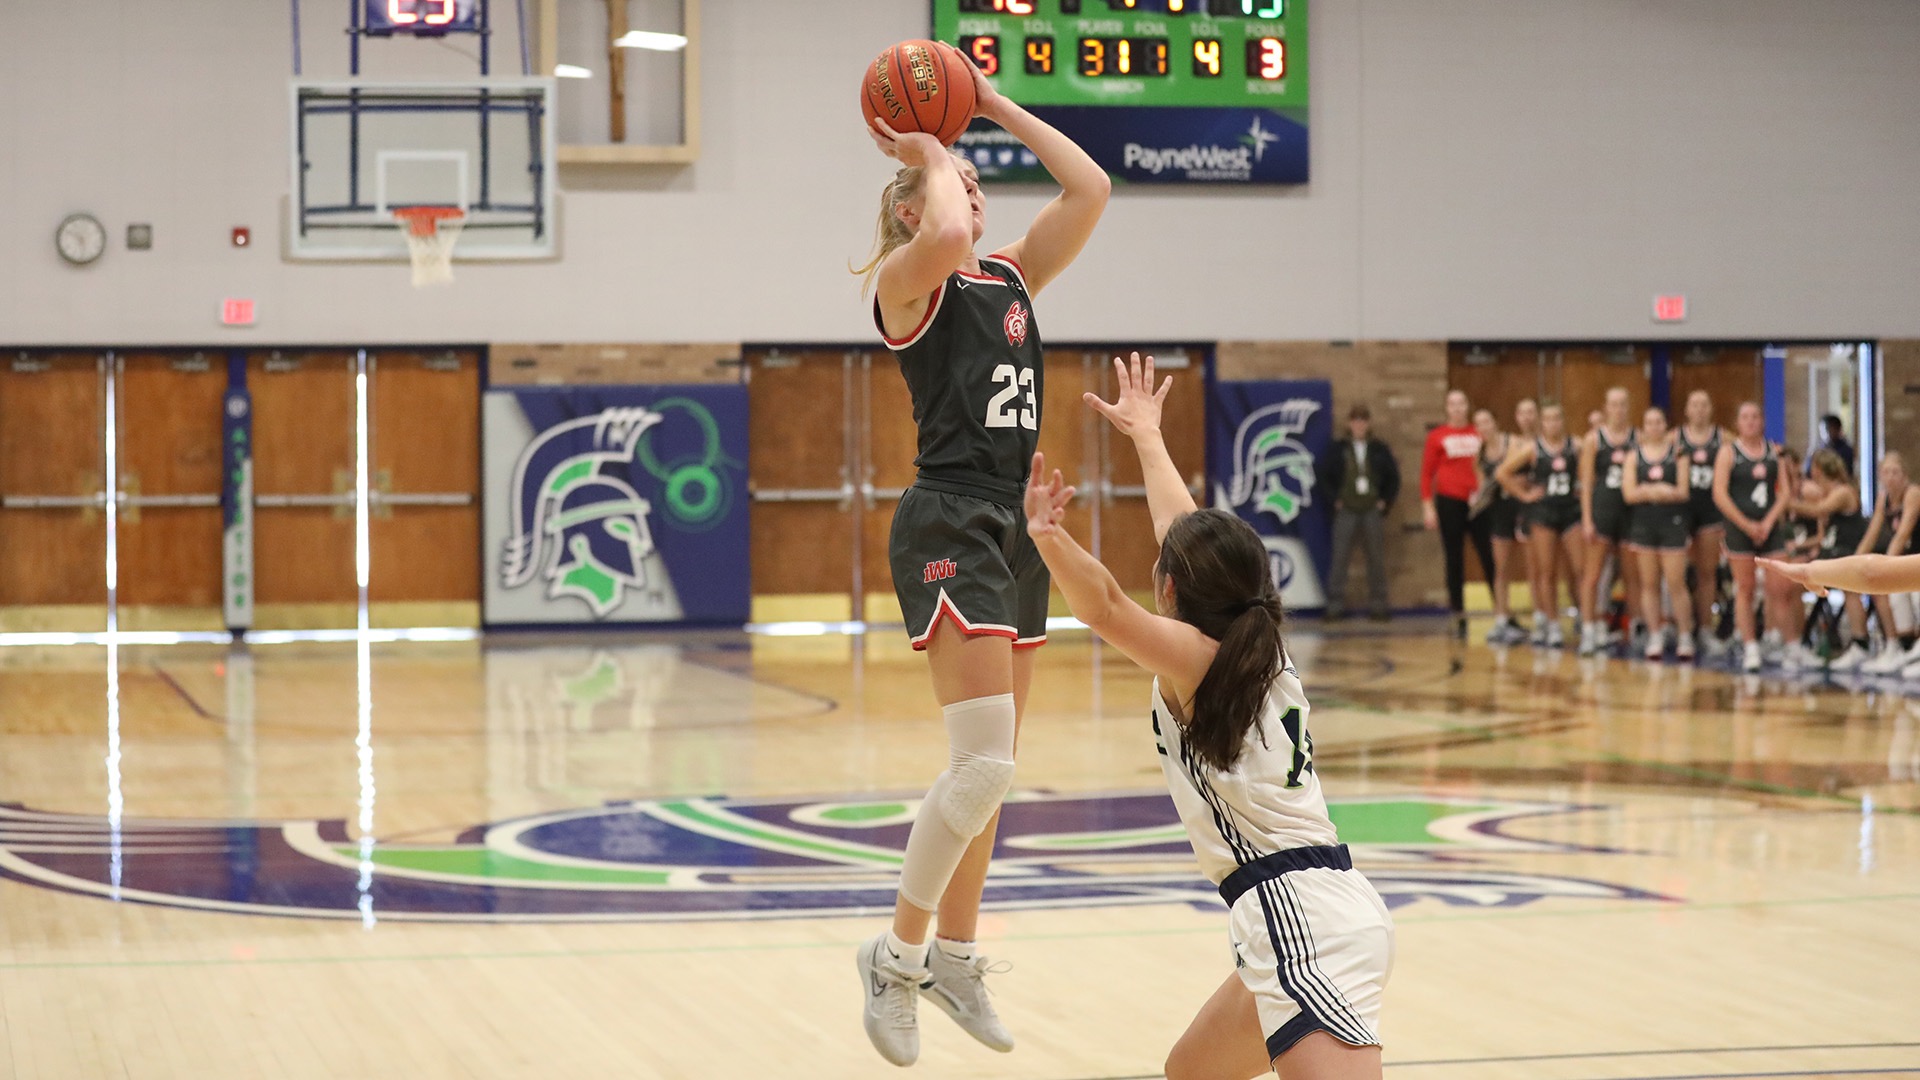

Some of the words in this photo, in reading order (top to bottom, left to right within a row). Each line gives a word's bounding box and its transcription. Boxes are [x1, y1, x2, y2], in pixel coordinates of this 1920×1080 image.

[972, 37, 998, 76] 5
[1027, 41, 1051, 73] 4
[1194, 40, 1220, 74] 4
[1261, 38, 1284, 79] 3
[1123, 142, 1252, 174] PayneWest
[984, 364, 1037, 430] 23
[1751, 481, 1768, 508] 4
